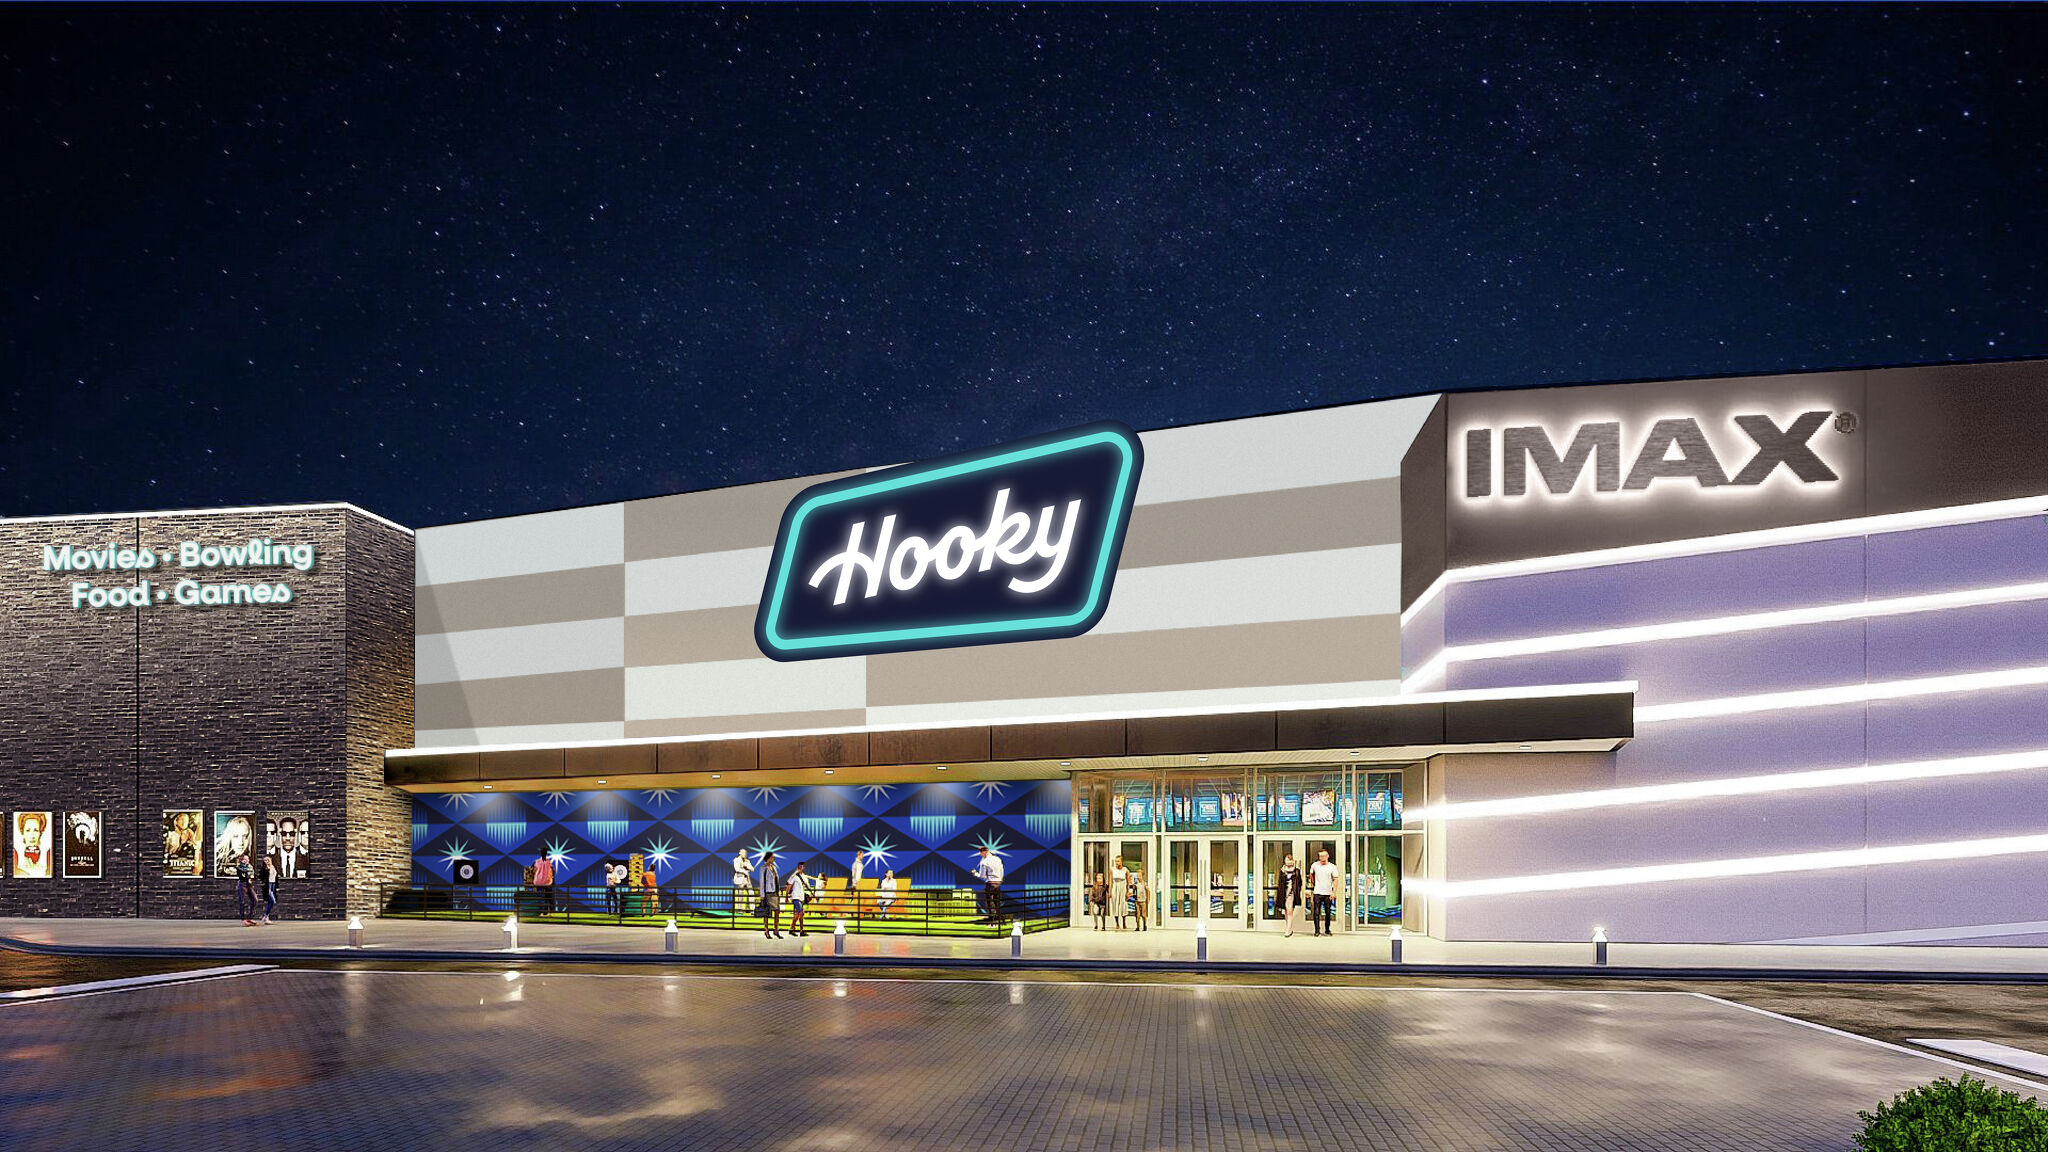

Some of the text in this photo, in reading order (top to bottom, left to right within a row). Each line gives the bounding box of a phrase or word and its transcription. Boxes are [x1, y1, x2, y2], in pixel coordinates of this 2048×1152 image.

[1466, 411, 1840, 498] IMAX
[43, 538, 315, 571] Movies Bowling
[808, 488, 1082, 606] Hooky
[72, 579, 293, 608] Food Games
